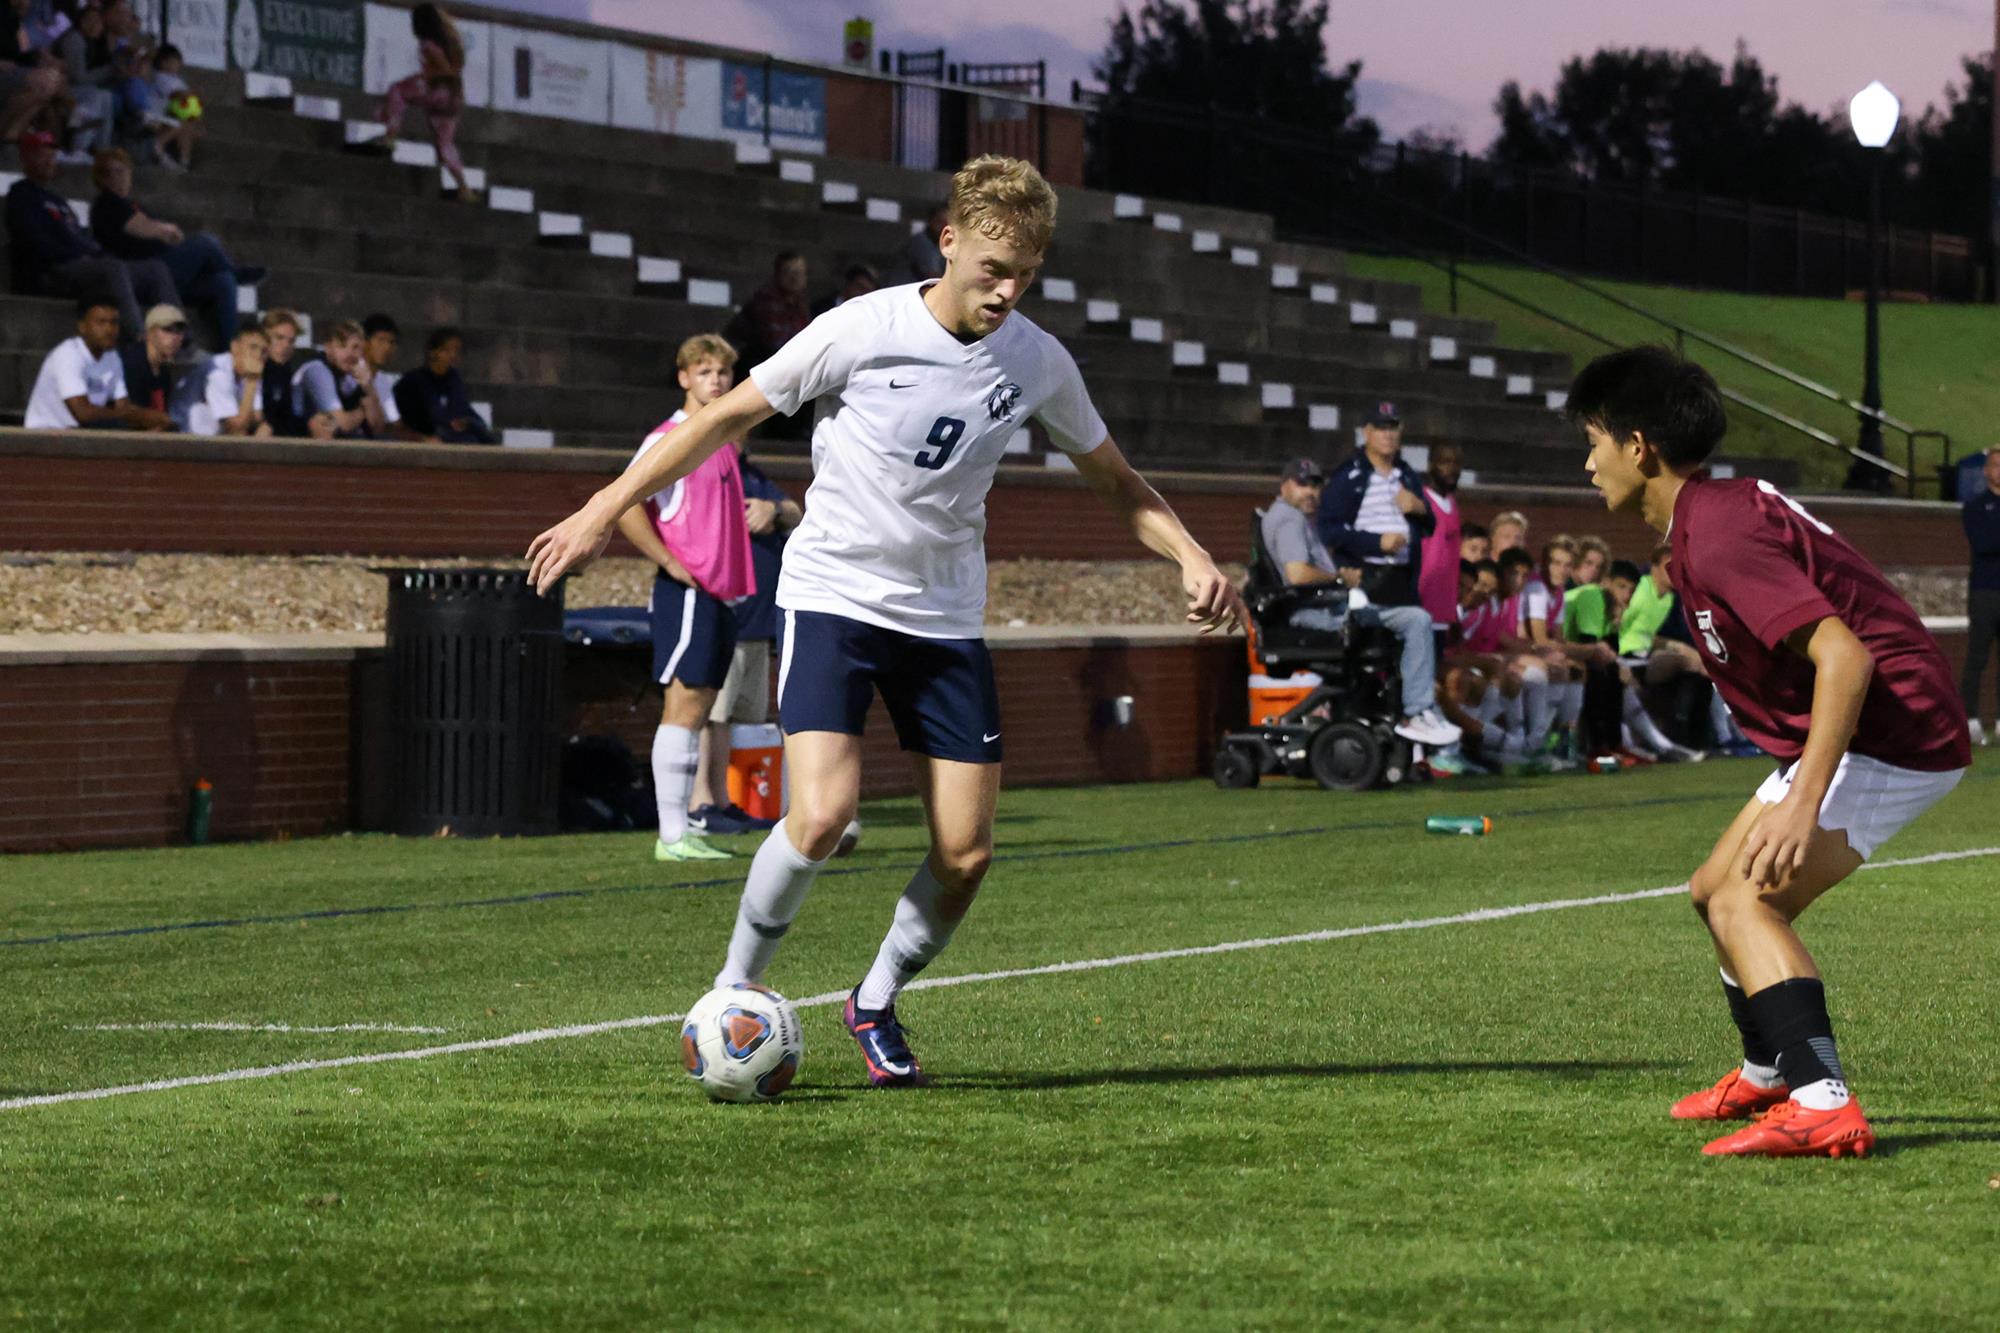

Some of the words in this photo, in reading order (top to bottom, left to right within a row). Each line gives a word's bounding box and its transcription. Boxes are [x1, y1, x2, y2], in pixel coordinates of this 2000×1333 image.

[263, 0, 355, 43] EXECUTIVE
[260, 41, 311, 77] LAWN
[312, 49, 355, 86] CARE
[914, 416, 966, 470] 9
